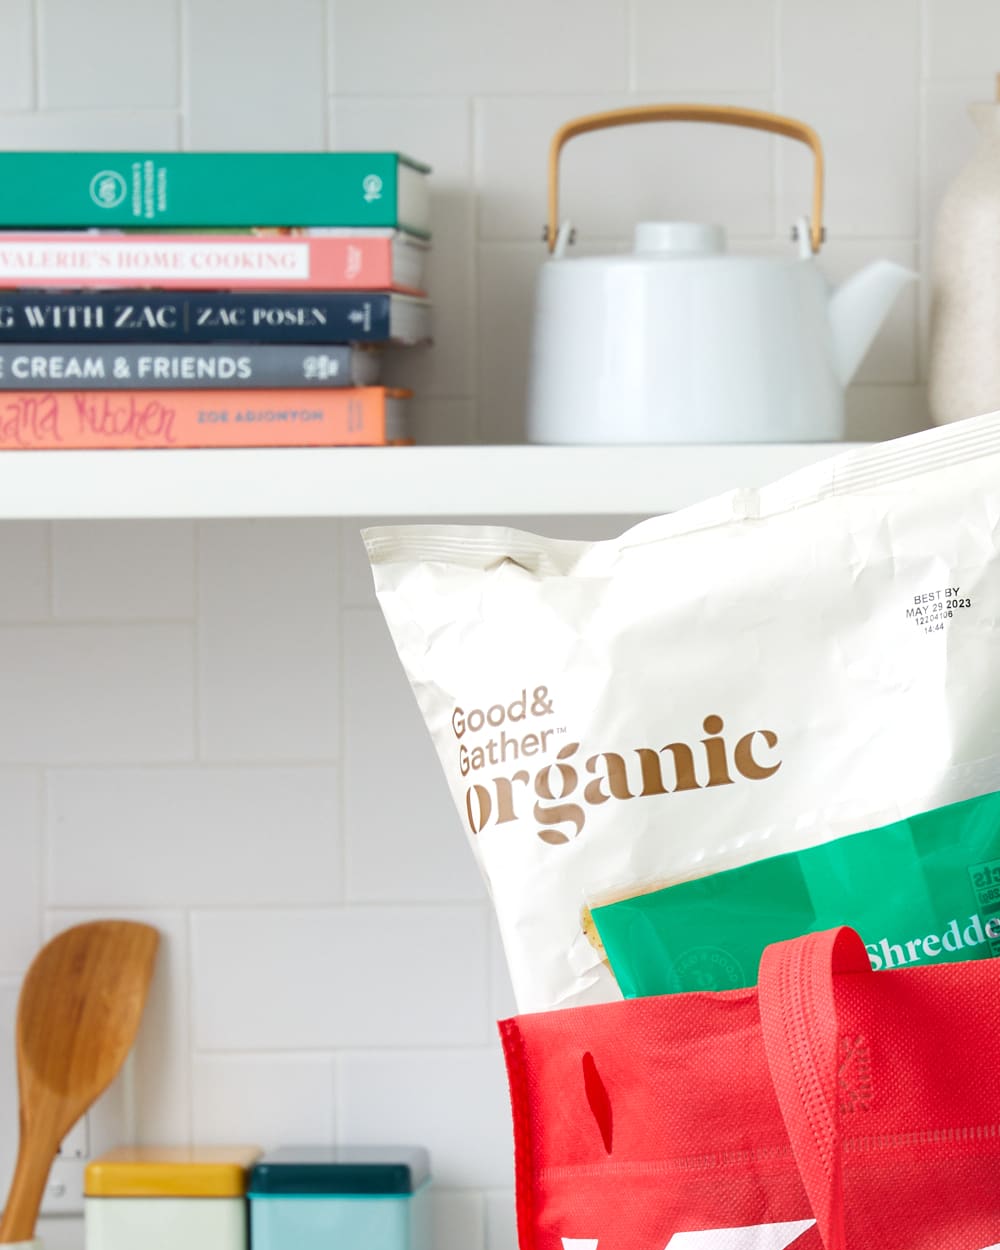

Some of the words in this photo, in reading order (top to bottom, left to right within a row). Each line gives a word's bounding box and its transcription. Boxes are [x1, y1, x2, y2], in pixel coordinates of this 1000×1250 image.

[0, 251, 111, 270] VALERIE'S
[116, 251, 185, 270] HOME
[190, 251, 297, 270] COOKING
[24, 305, 104, 329] WITH
[114, 305, 177, 329] ZAC
[197, 307, 246, 327] ZAC
[252, 307, 328, 327] POSEN
[11, 355, 105, 379] CREAM
[112, 356, 131, 379] &
[138, 355, 252, 380] FRIENDS
[914, 590, 941, 605] BEST
[945, 587, 960, 598] BY
[906, 606, 929, 618] MAY
[932, 602, 943, 613] 29
[946, 599, 971, 609] 2023
[466, 714, 783, 846] organic
